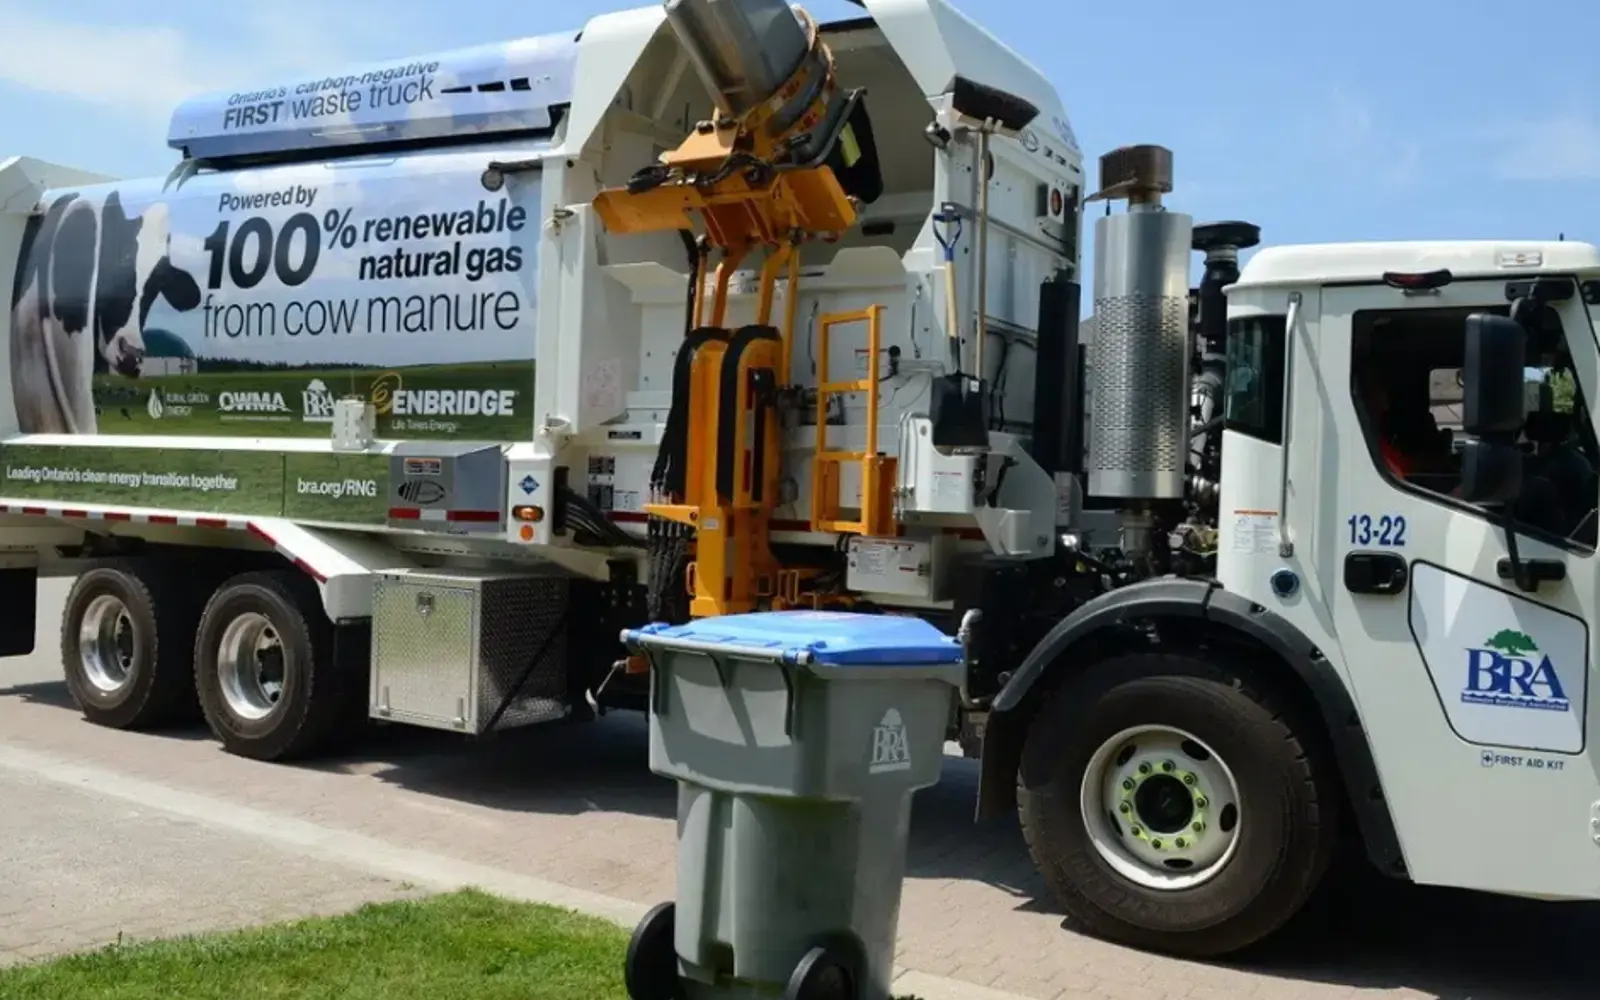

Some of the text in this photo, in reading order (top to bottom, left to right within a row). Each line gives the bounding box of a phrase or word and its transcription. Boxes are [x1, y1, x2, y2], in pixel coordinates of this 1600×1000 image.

[228, 61, 439, 106] Ontario's carbon-negative
[223, 76, 434, 129] FIRST waste truck
[218, 184, 318, 213] Powered by
[203, 198, 526, 290] 100% renewable
[359, 241, 523, 282] natural gas
[203, 290, 520, 338] from cow manure
[218, 391, 291, 412] OWMA
[301, 389, 336, 417] BRA
[392, 389, 515, 417] ENBRIDGE
[6, 465, 238, 491] Leading Ontario's clean energy transition together
[297, 477, 377, 498] bra.org/RNG
[1347, 513, 1406, 546] 13-22
[1464, 647, 1569, 699] BRA
[869, 725, 911, 764] BRA
[1494, 754, 1565, 771] FIRST AID KIT
